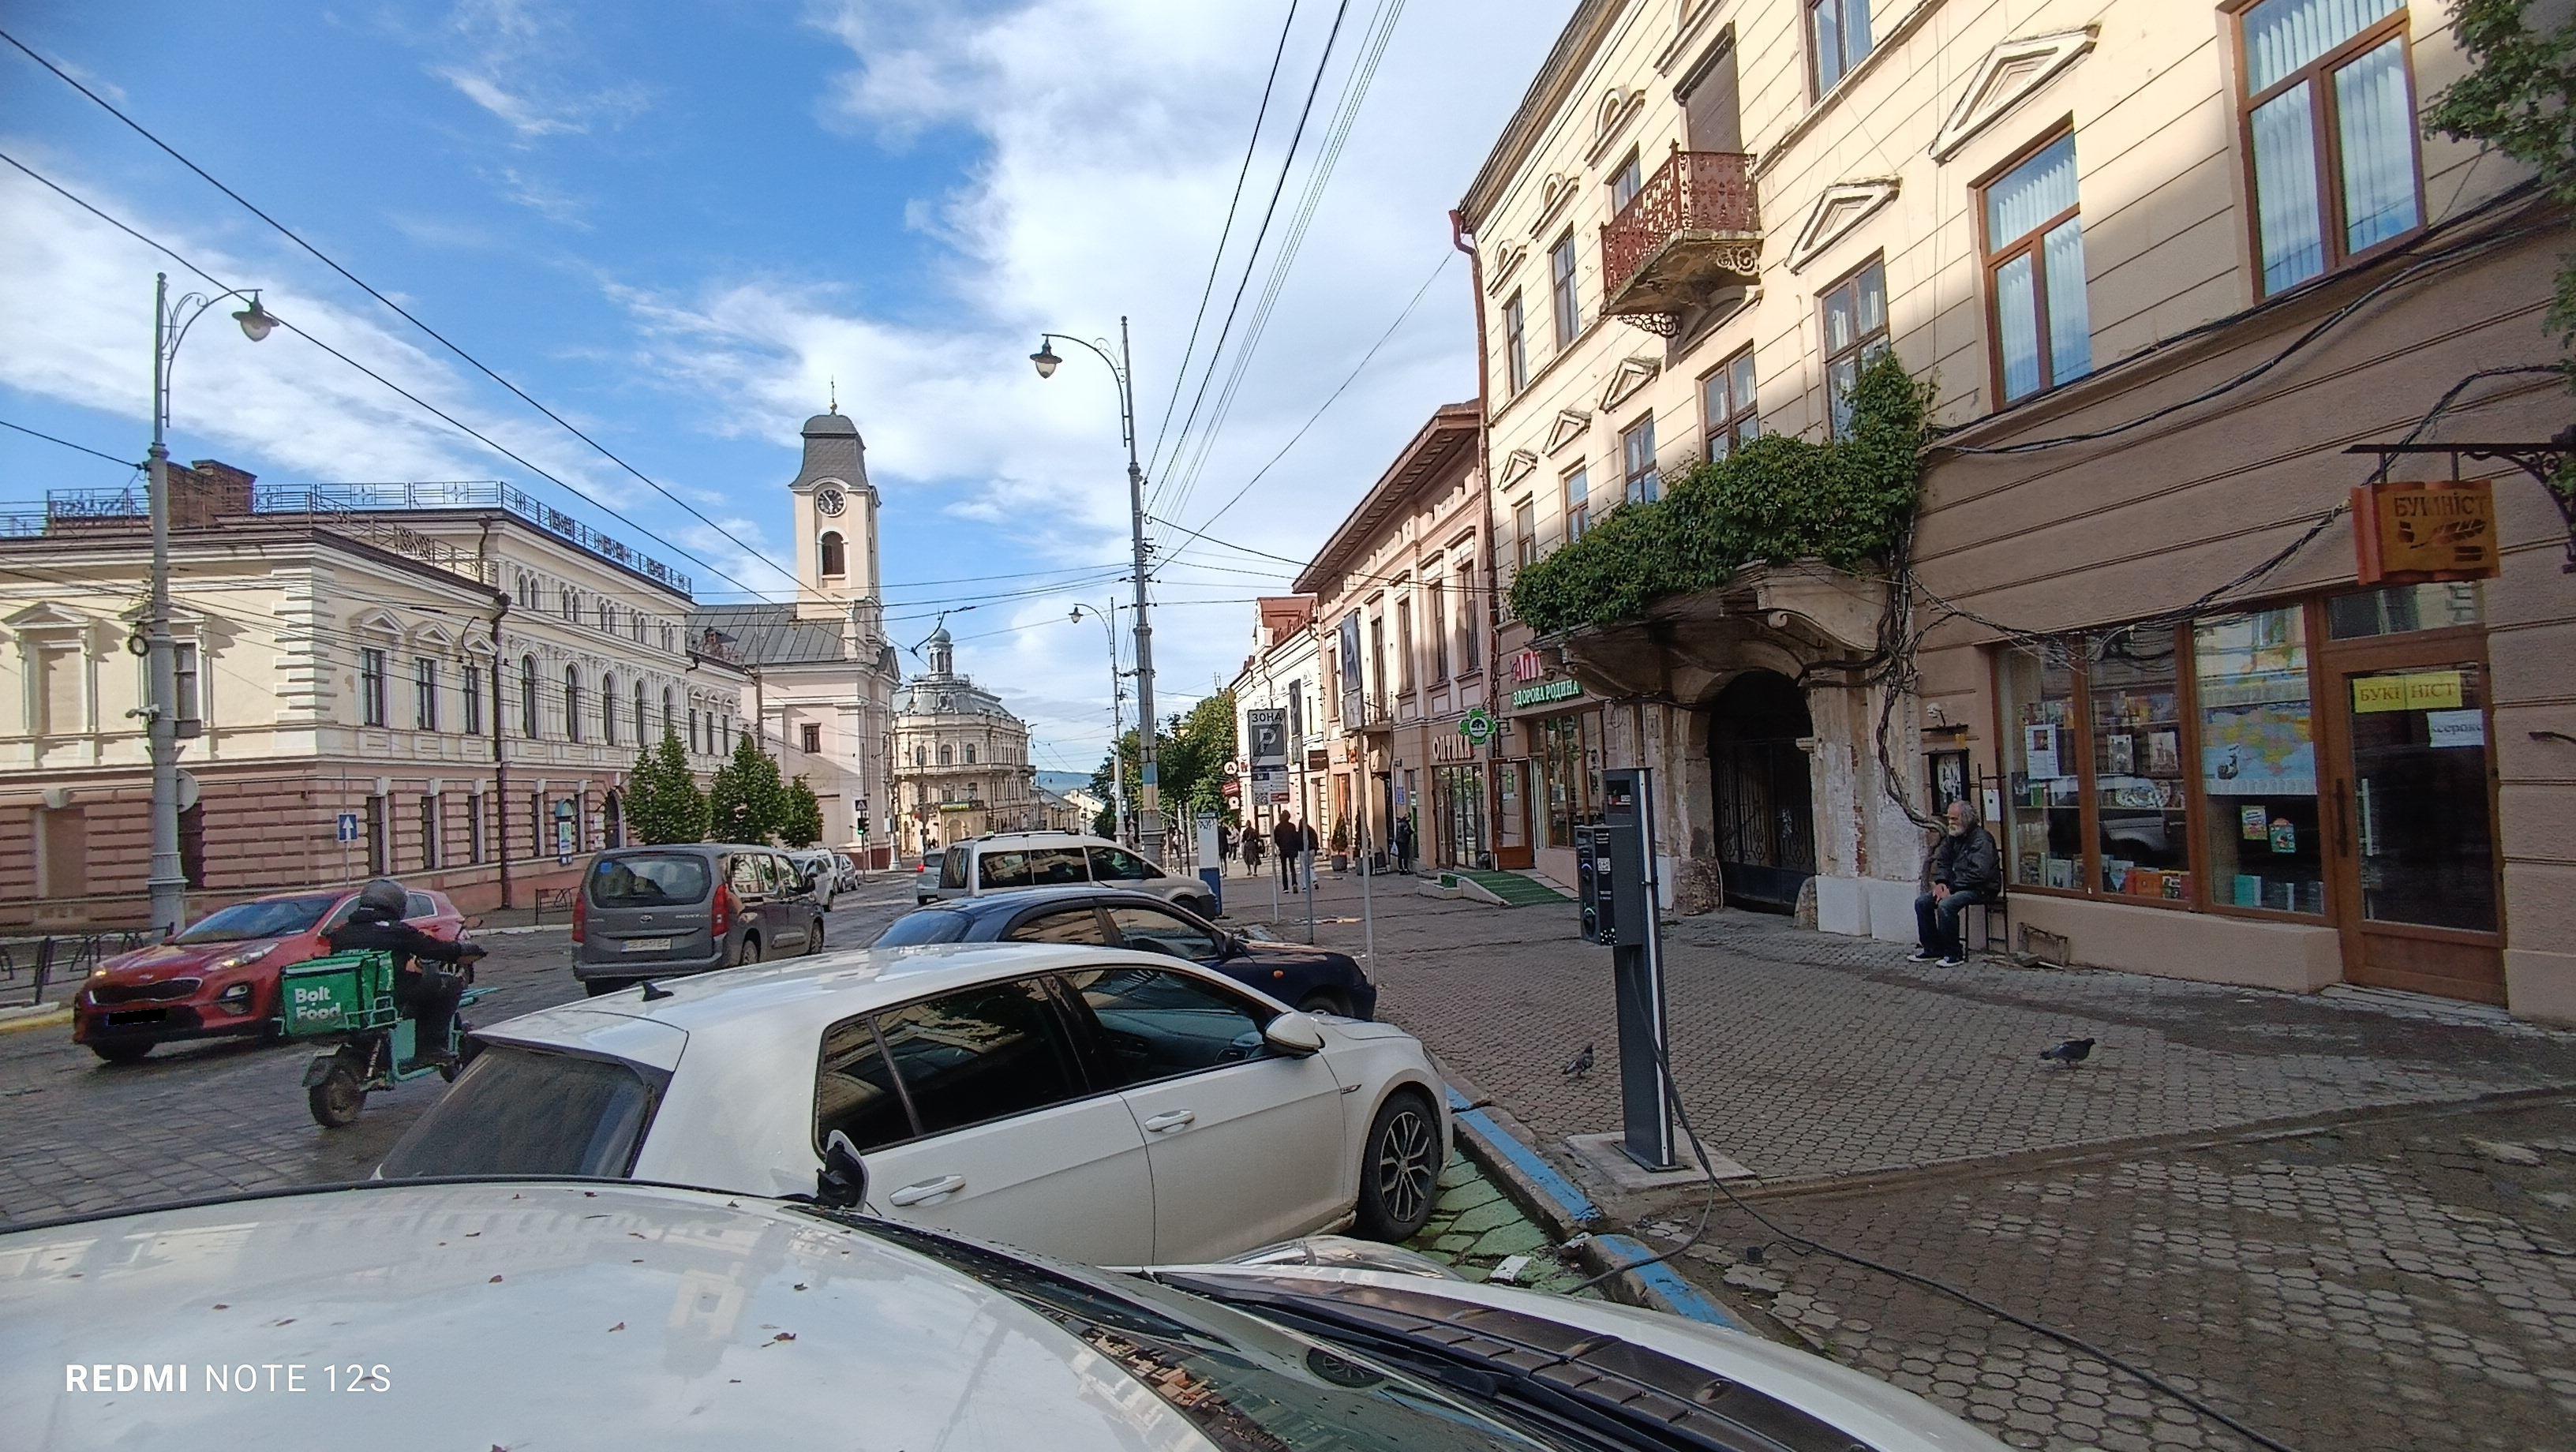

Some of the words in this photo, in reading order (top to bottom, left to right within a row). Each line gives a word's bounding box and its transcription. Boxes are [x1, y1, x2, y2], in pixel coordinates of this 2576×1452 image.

[1513, 685, 1544, 707] ЗДОРОВА
[1545, 679, 1579, 702] РОДИНА
[1252, 712, 1282, 723] ЗОНА
[1432, 733, 1470, 760] ОПТИКА
[294, 986, 331, 1003] Bolt
[296, 1002, 342, 1020] Food
